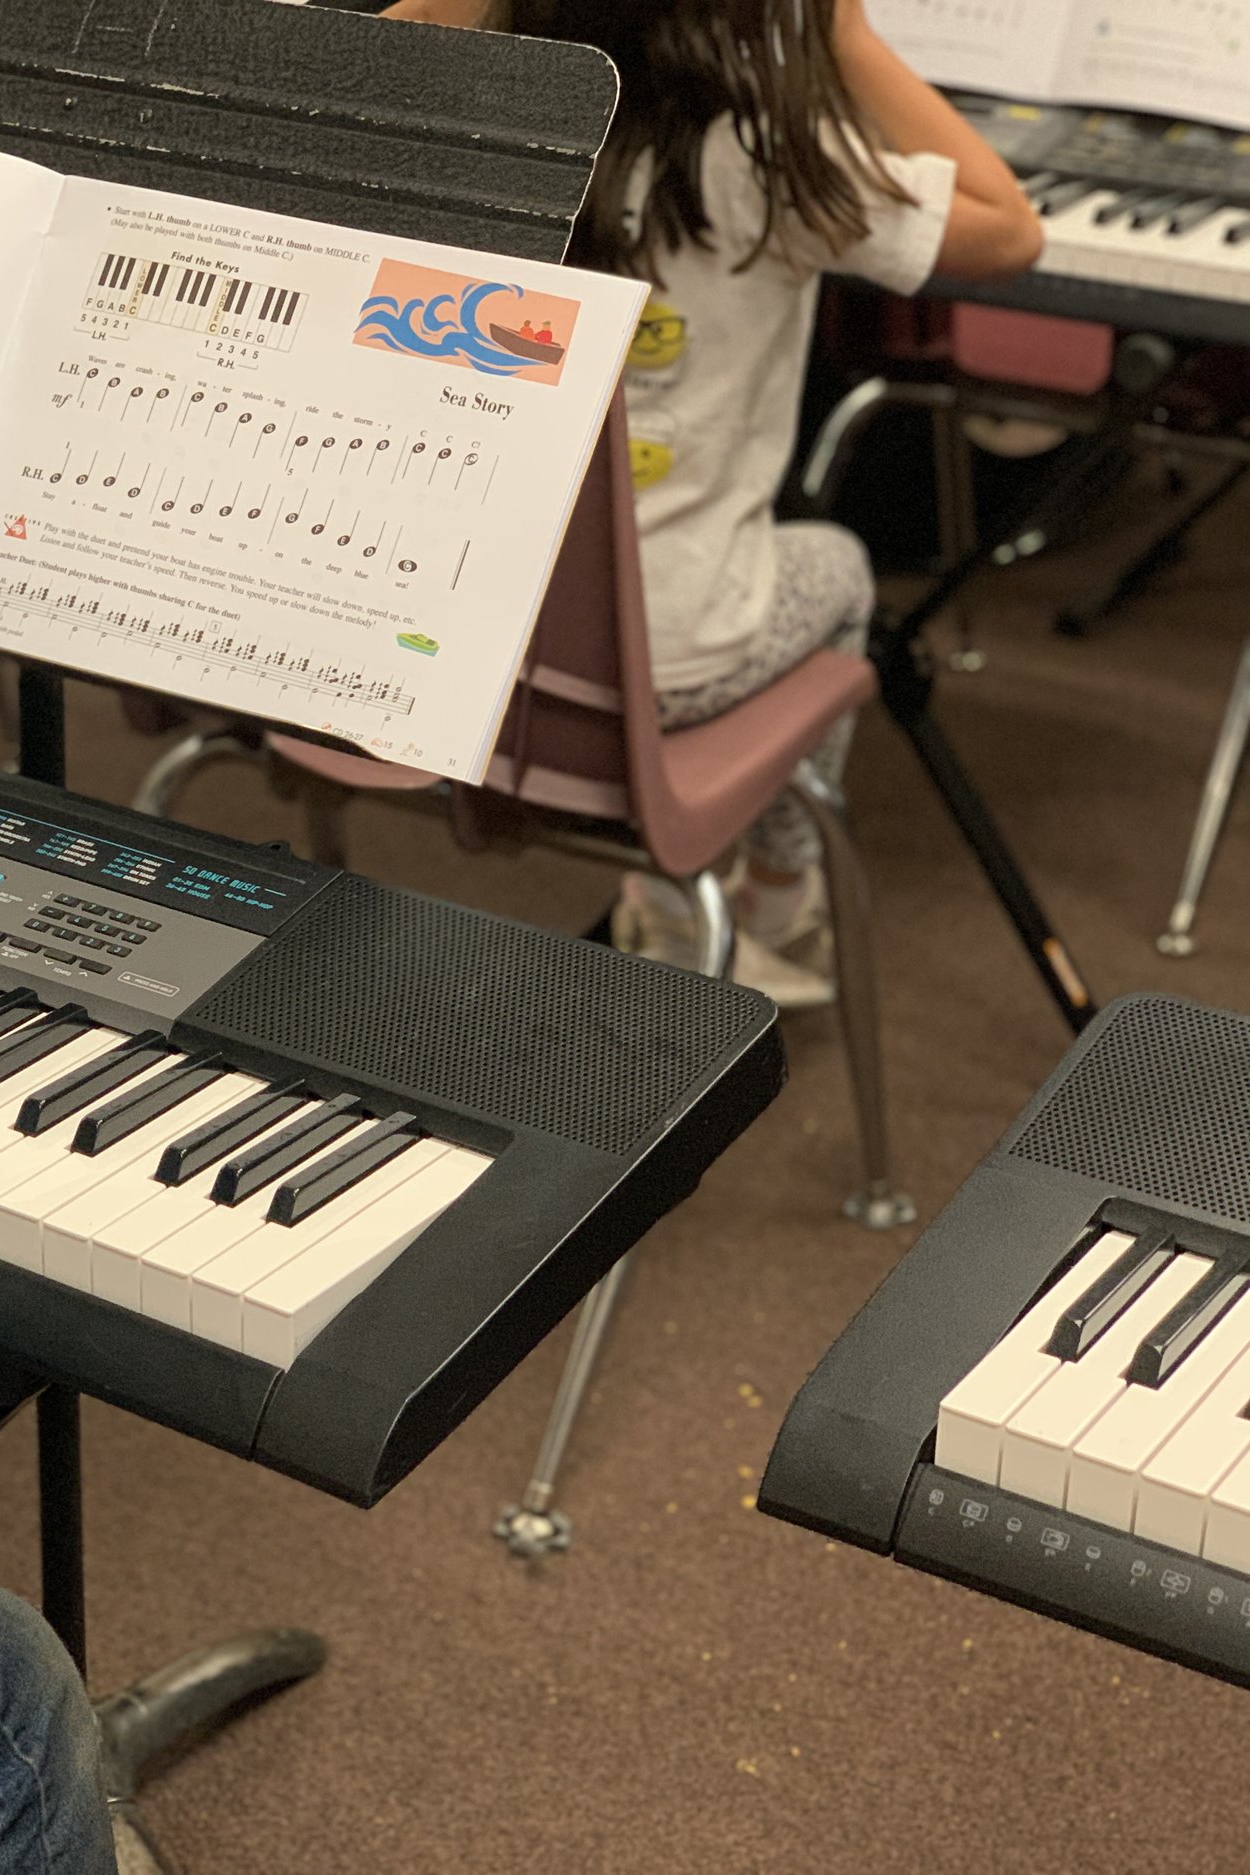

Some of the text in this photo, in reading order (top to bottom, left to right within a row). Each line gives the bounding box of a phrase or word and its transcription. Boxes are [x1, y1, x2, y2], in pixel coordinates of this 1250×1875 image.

[110, 218, 128, 230] (May
[129, 221, 144, 232] also
[145, 224, 154, 233] be
[154, 226, 179, 240] played
[179, 231, 195, 242] with
[197, 233, 213, 244] both
[214, 237, 241, 250] thumbs
[253, 245, 280, 258] Middle
[132, 209, 147, 219] with
[147, 211, 165, 223] L.H.
[166, 213, 191, 227] thumb
[192, 221, 202, 230] on
[209, 224, 241, 238] LOWER
[243, 231, 250, 239] C
[251, 232, 265, 243] and
[266, 235, 284, 246] R.H.
[286, 238, 312, 252] thumb
[325, 246, 361, 262] MIDDLE
[362, 254, 371, 263] C.
[171, 251, 240, 274] Find the Keys
[85, 297, 137, 315] F G A B C
[209, 323, 265, 344] C D E F G
[215, 342, 223, 351] 2
[227, 345, 235, 354] 3
[240, 348, 247, 357] 4
[252, 350, 260, 360] 5
[59, 362, 80, 376] L.H.
[217, 358, 235, 369] R.H.
[242, 389, 263, 401] splash
[305, 405, 319, 415] ride
[332, 410, 343, 420] the
[353, 415, 373, 427] storm
[439, 385, 515, 421] Sea Story
[21, 465, 44, 481] R.H.
[119, 510, 133, 520] and
[151, 518, 171, 530] guide
[180, 527, 196, 537] your
[238, 541, 248, 551] up
[301, 556, 312, 566] the
[326, 562, 342, 574] deep
[354, 569, 369, 580] blue
[40, 535, 61, 546] Listen
[62, 539, 75, 550] and
[77, 543, 100, 556] follow
[100, 550, 119, 561] your
[179, 569, 198, 582] Then
[230, 583, 245, 596] You
[246, 589, 268, 603] speed
[268, 596, 279, 606] up
[280, 598, 288, 606] or
[290, 599, 307, 612] slow
[309, 603, 330, 617] down
[331, 608, 344, 619] the
[345, 613, 377, 629] melody!
[44, 523, 59, 535] Play
[61, 526, 76, 538] with
[78, 530, 89, 540] the
[90, 533, 106, 545] duet
[108, 538, 121, 548] and
[122, 541, 150, 557] pretend
[151, 551, 169, 562] your
[170, 554, 186, 565] boat
[188, 558, 201, 569] has
[202, 563, 227, 579] engine
[228, 569, 256, 585] trouble.
[259, 577, 276, 591] Your
[278, 583, 305, 598] teacher
[306, 590, 321, 602] will
[322, 595, 339, 607] slow
[366, 606, 389, 619] speed
[403, 615, 417, 626] etc.
[18, 555, 37, 567] Duet:
[38, 559, 67, 575] (Student
[68, 567, 88, 580] plays
[88, 572, 111, 587] higher
[112, 579, 129, 591] with
[130, 584, 158, 598] thumbs
[158, 591, 186, 608] sharing
[187, 600, 195, 608] C
[195, 601, 207, 612] for
[208, 604, 220, 615] the
[221, 608, 241, 621] duet)
[383, 741, 393, 749] 15
[413, 748, 423, 757] 10
[197, 869, 230, 885] DANCE
[229, 879, 261, 894] MUSIC
